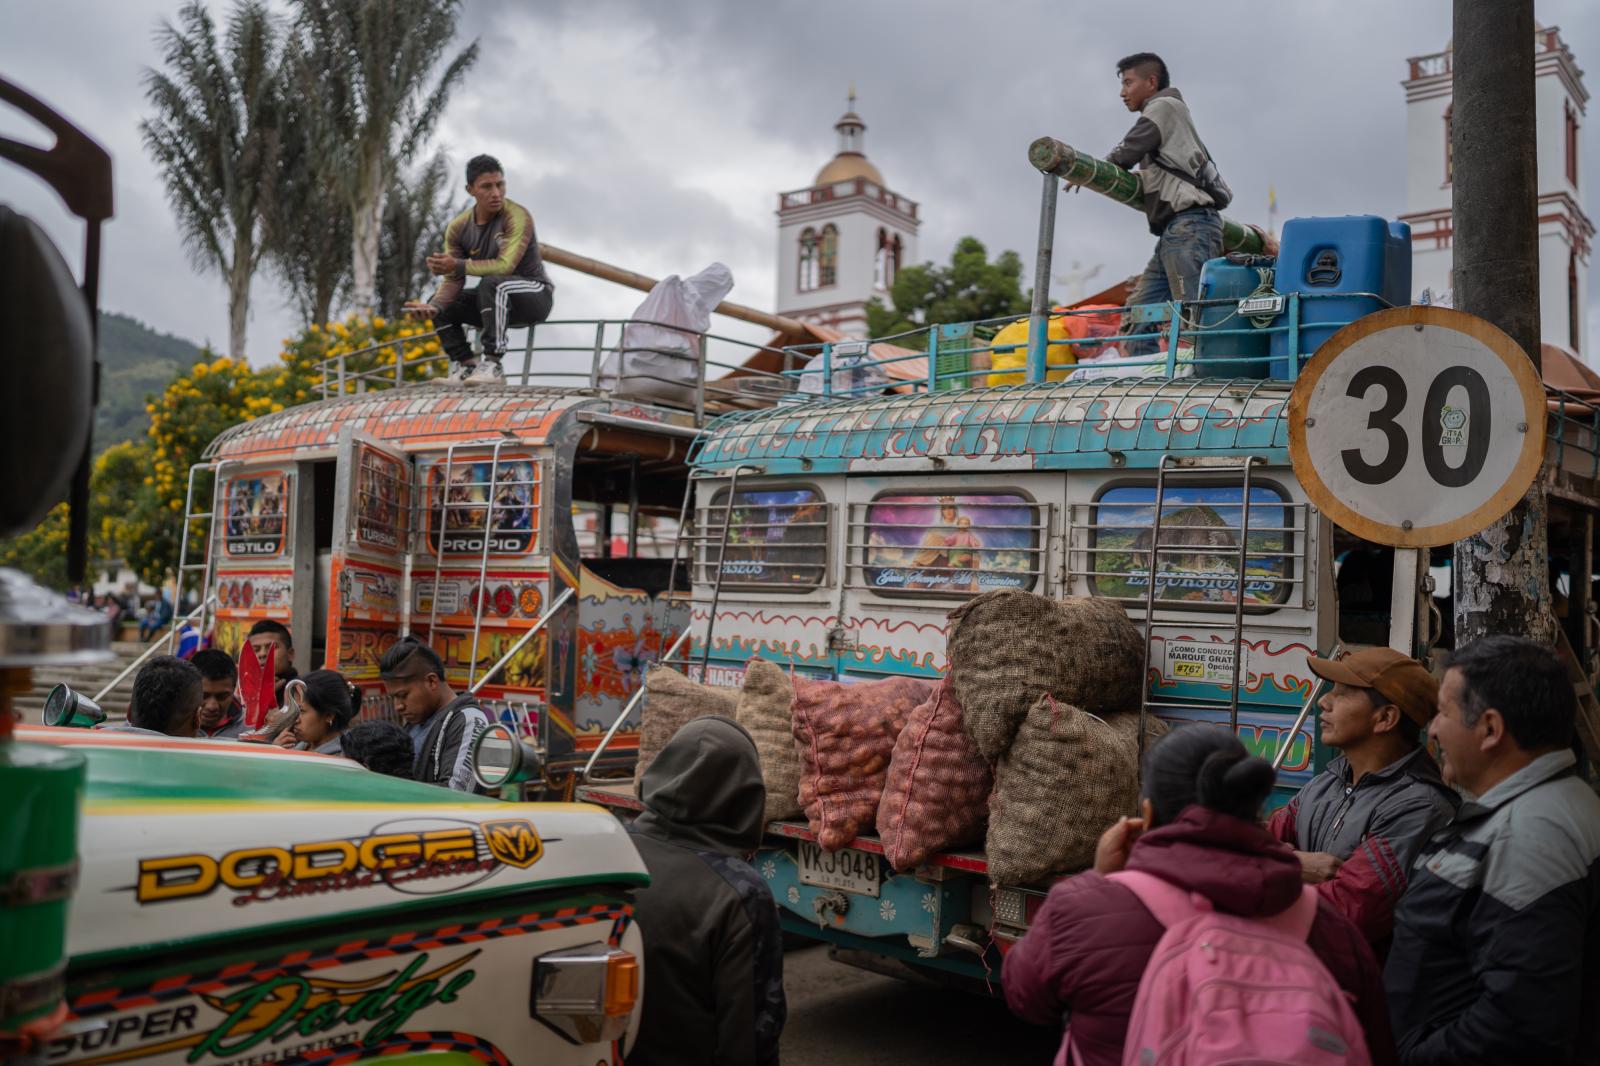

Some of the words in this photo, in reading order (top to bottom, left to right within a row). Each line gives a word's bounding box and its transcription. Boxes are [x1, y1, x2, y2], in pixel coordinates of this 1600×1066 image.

[1340, 365, 1491, 488] 30
[362, 527, 398, 546] TURISMO
[229, 541, 276, 553] ESTILO
[715, 560, 765, 574] ASEOS
[1168, 653, 1206, 661] MARQUE
[1197, 647, 1237, 656] CONDUZC
[136, 828, 478, 906] DODGE
[46, 1004, 198, 1059] SUPER
[187, 952, 477, 1065] Dodge
